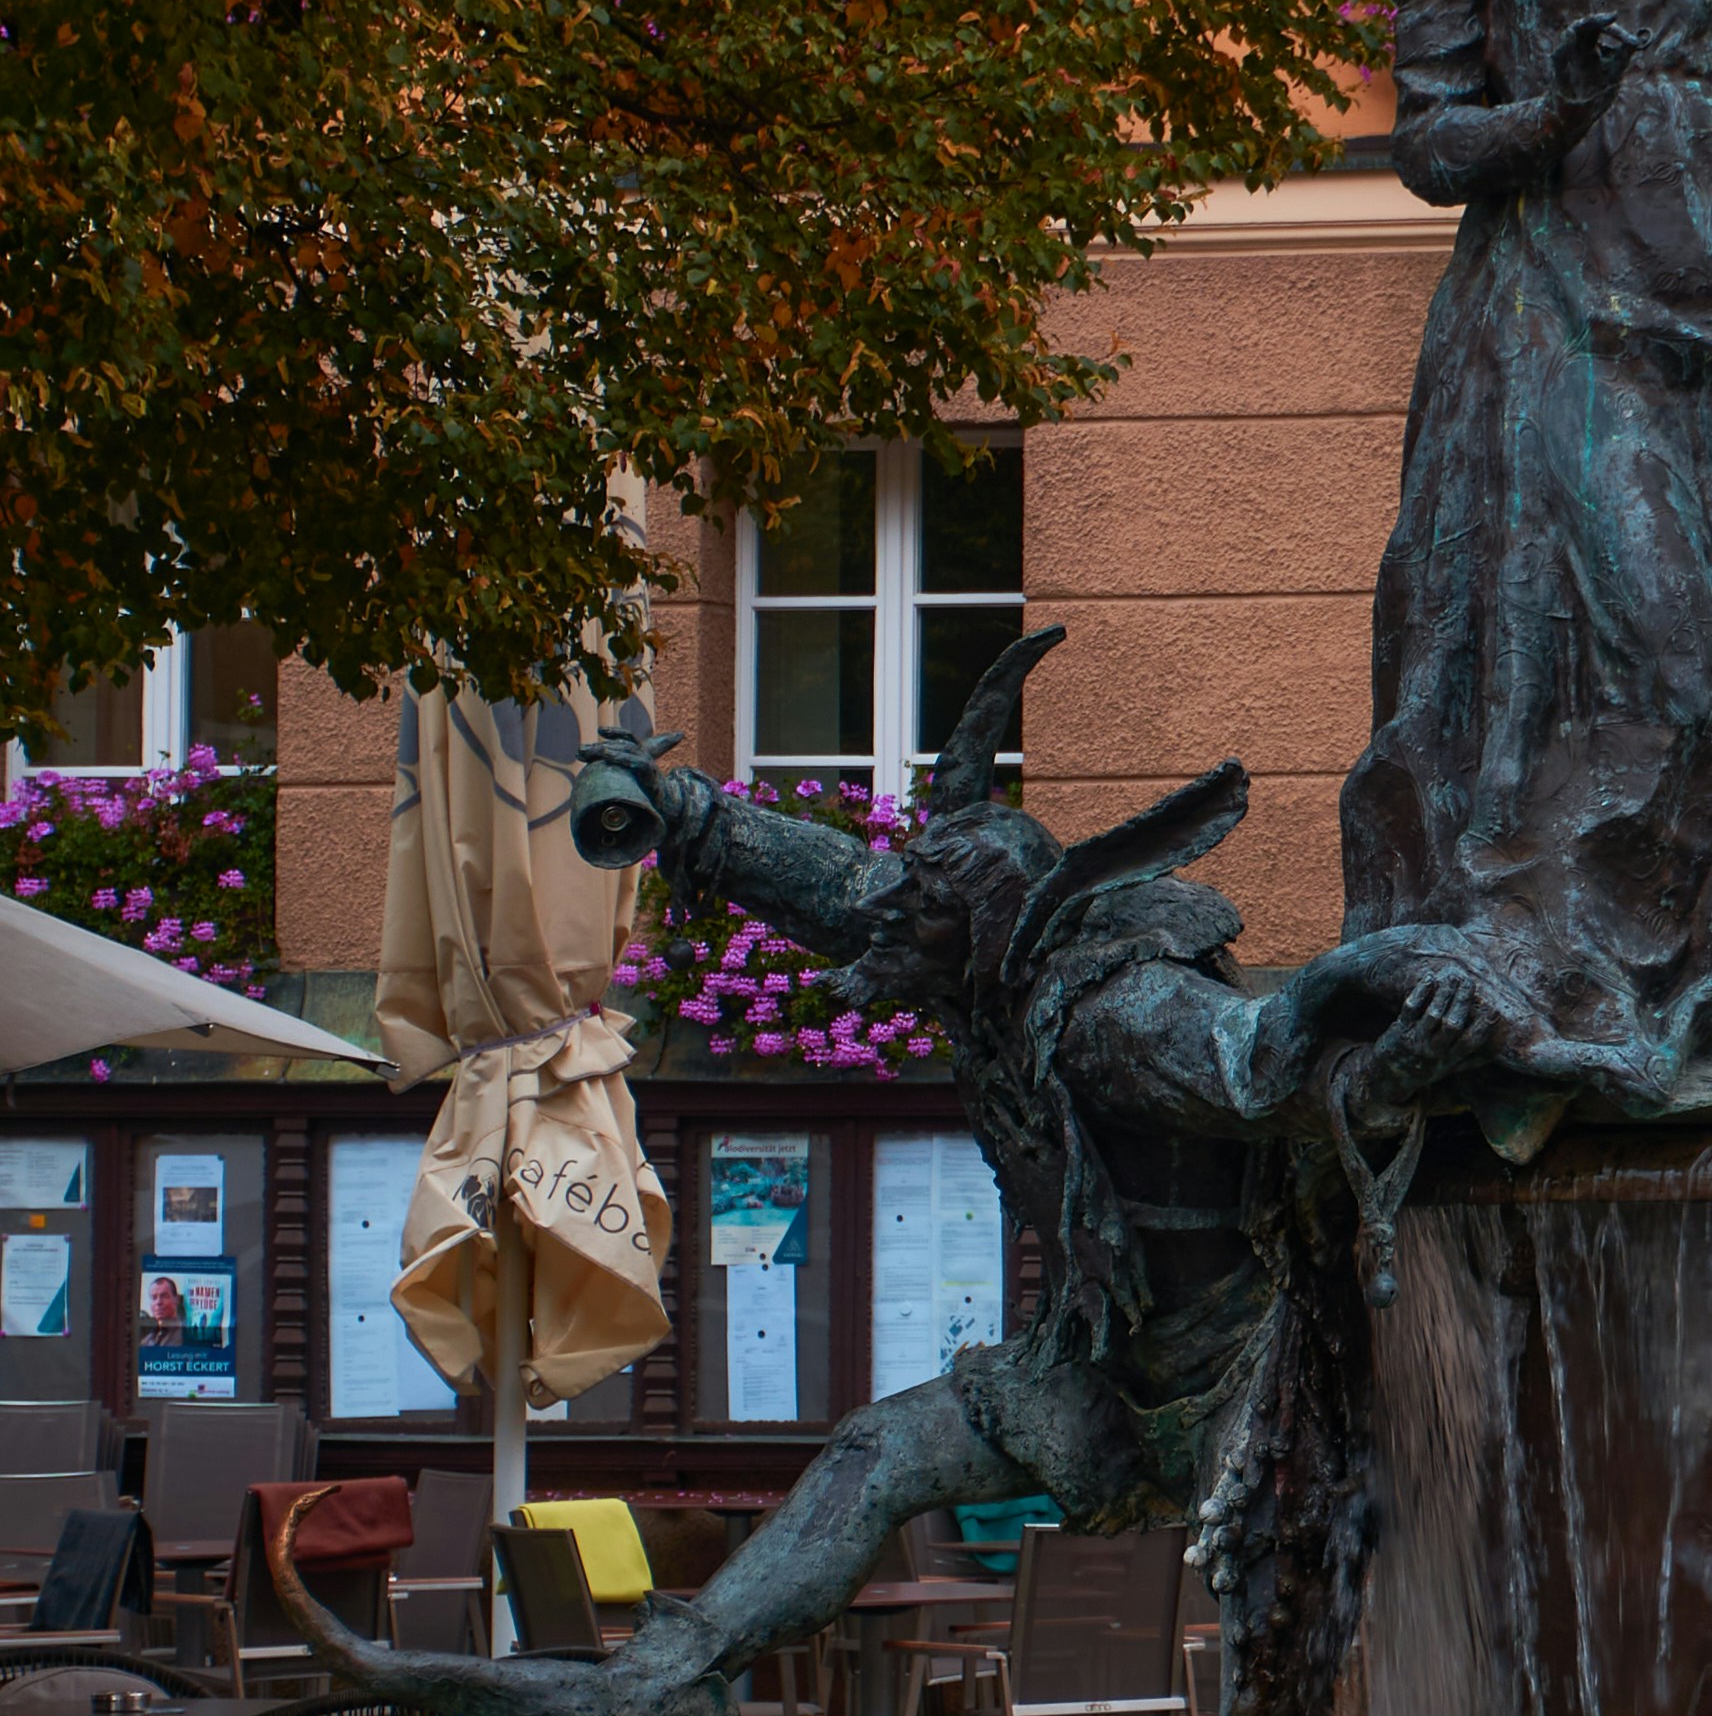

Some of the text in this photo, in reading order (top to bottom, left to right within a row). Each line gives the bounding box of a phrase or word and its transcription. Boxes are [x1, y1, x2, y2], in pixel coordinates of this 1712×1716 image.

[778, 1144, 797, 1154] jetzt
[195, 1286, 220, 1298] NAMEN
[167, 1351, 194, 1362] Lesung
[144, 1360, 230, 1373] HORST ECKERT
